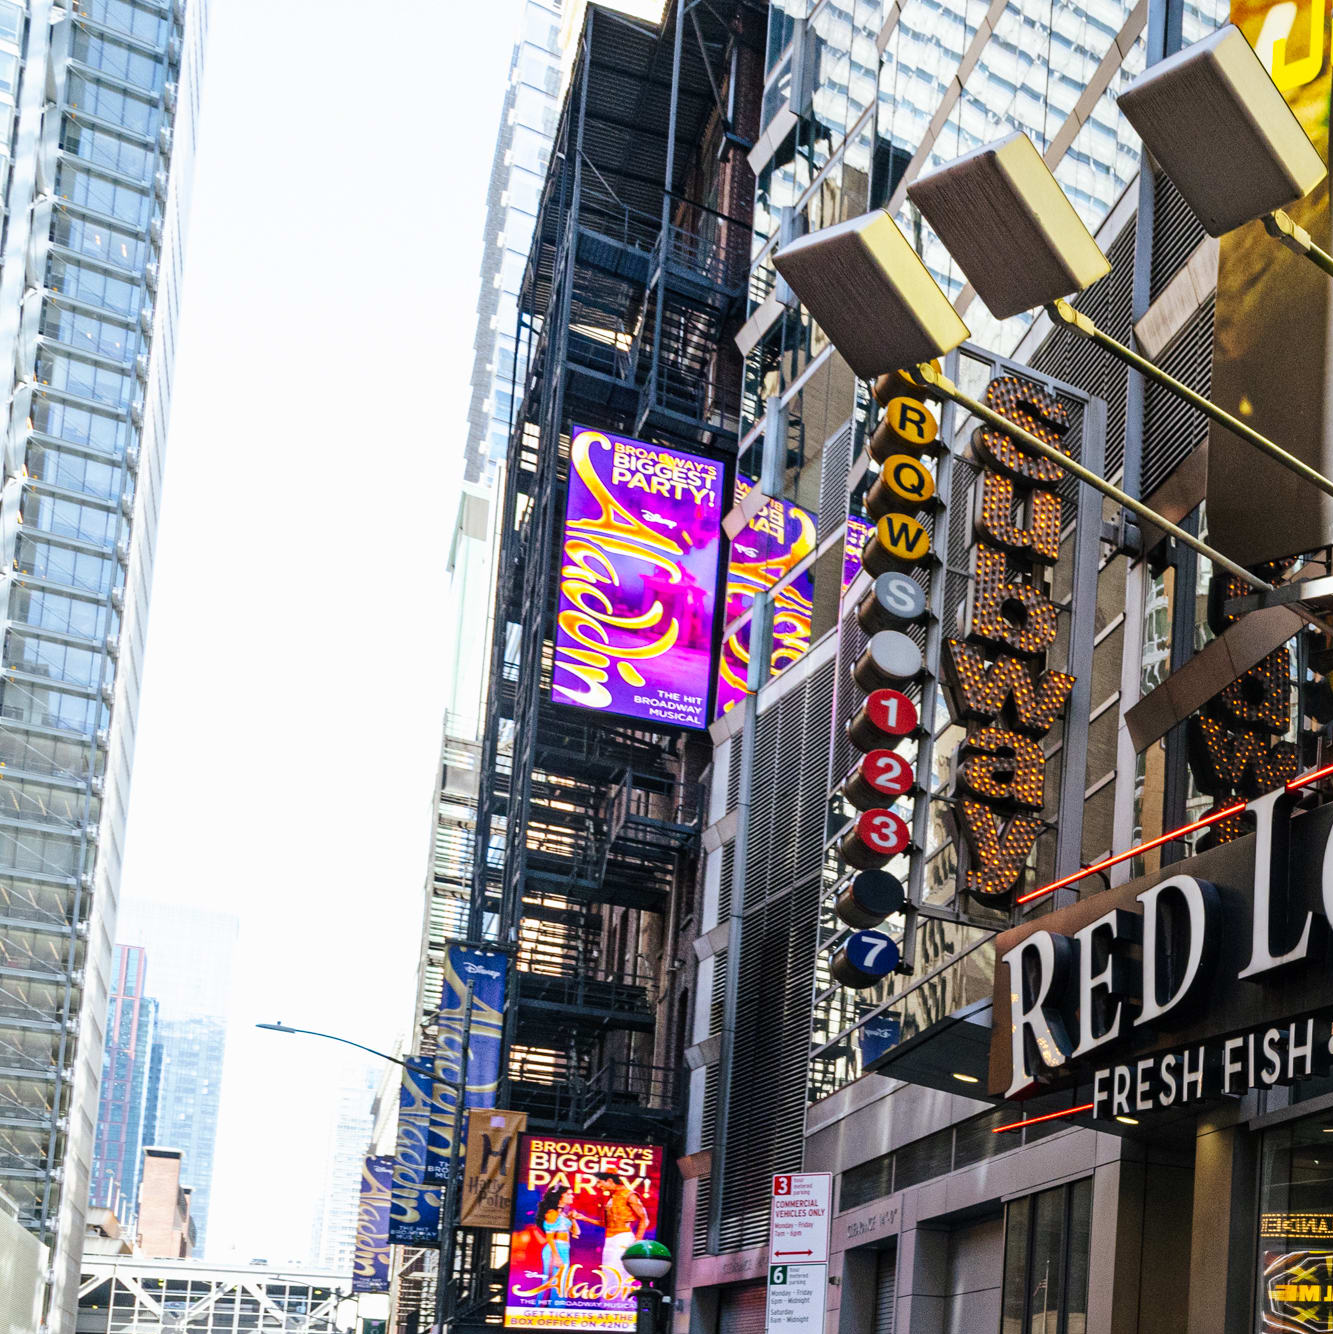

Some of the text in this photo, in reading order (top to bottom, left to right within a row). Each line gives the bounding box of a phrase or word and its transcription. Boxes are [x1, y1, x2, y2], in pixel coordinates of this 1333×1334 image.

[899, 403, 926, 439] R
[613, 452, 717, 490] BIGGEST
[893, 462, 925, 498] Q
[611, 467, 716, 508] PARTY!
[886, 516, 924, 553] W
[551, 430, 684, 709] Aladdin
[885, 579, 916, 612] S
[633, 695, 703, 715] BROADWAY
[657, 690, 703, 707] THE HIT
[649, 707, 703, 725] MUSICAL
[880, 697, 898, 728] 1
[875, 757, 902, 790] 2
[870, 816, 899, 847] 3
[861, 936, 888, 968] 7
[1003, 873, 1206, 1101] RED
[1092, 1048, 1206, 1120] FRESH
[1222, 1017, 1314, 1097] FISH
[530, 1139, 654, 1161] BROADWAY'S
[529, 1151, 653, 1177] BIGGEST
[527, 1169, 652, 1199] PARY!
[777, 1177, 789, 1194] 3
[775, 1199, 819, 1209] COMMERCIAL
[775, 1208, 826, 1218] VEHICLES ONLY
[775, 1221, 814, 1231] Monday Friday
[773, 1266, 784, 1284] 6
[519, 1298, 535, 1306] THE
[537, 1299, 552, 1307] HIT
[554, 1299, 602, 1308] BROADWAY
[771, 1289, 813, 1298] Monday Friday
[787, 1297, 811, 1305] Midnight
[510, 1317, 630, 1330] BOX OFFICE ON 42ND
[523, 1310, 634, 1322] GET TICKETS AT THE
[770, 1308, 794, 1317] Saturday
[786, 1315, 810, 1323] Midnight
